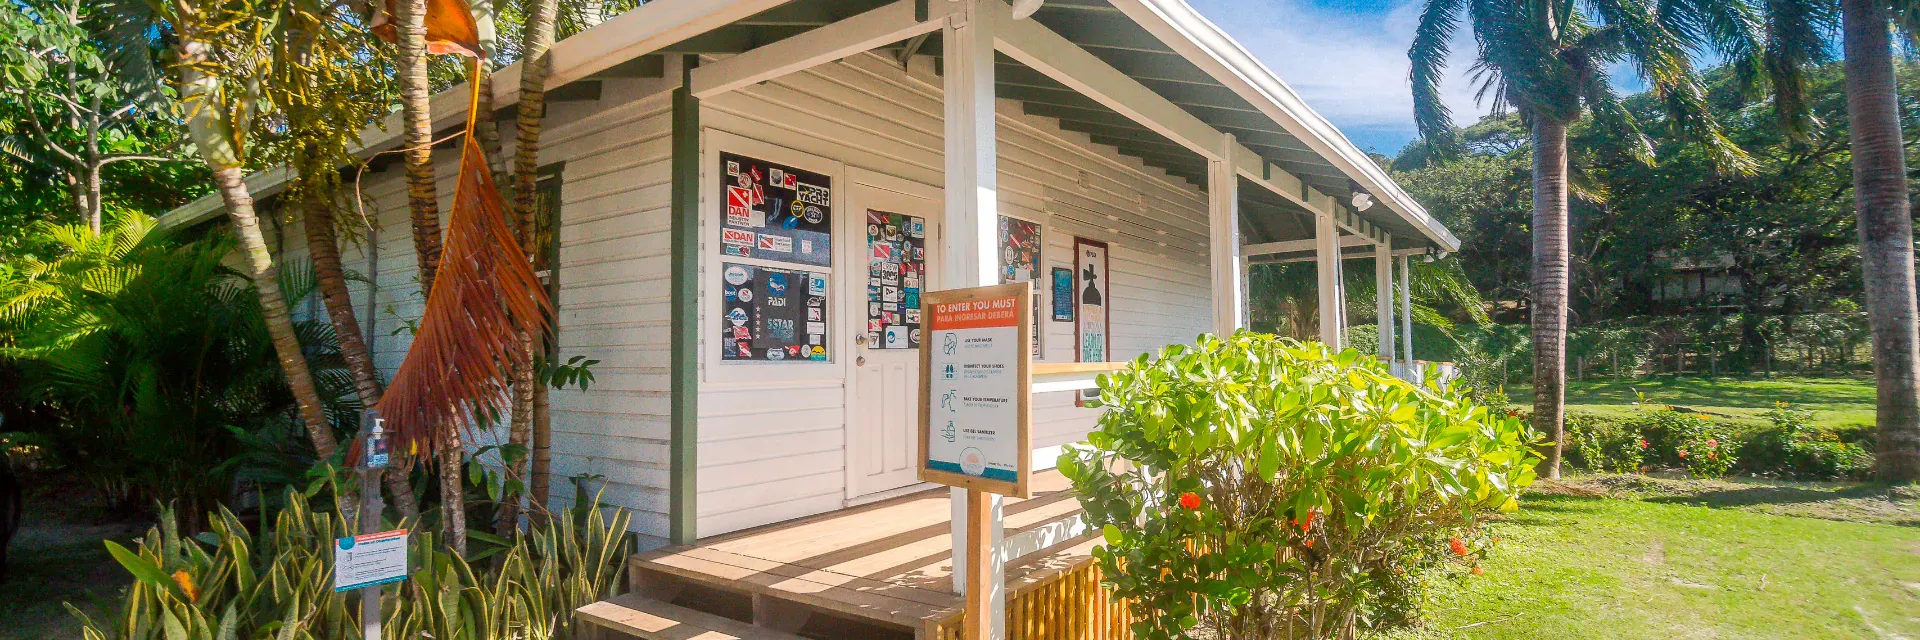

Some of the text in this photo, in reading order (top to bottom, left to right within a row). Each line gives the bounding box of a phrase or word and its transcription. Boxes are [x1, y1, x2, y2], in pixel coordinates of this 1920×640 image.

[809, 187, 829, 198] PRO
[799, 191, 829, 206] YACHT
[728, 206, 750, 218] DAN
[734, 231, 754, 242] DAN
[767, 296, 786, 307] PADI
[936, 298, 1016, 314] TO ENTER YOU MUST
[936, 314, 953, 323] PARA
[954, 312, 987, 322] INGRESAR
